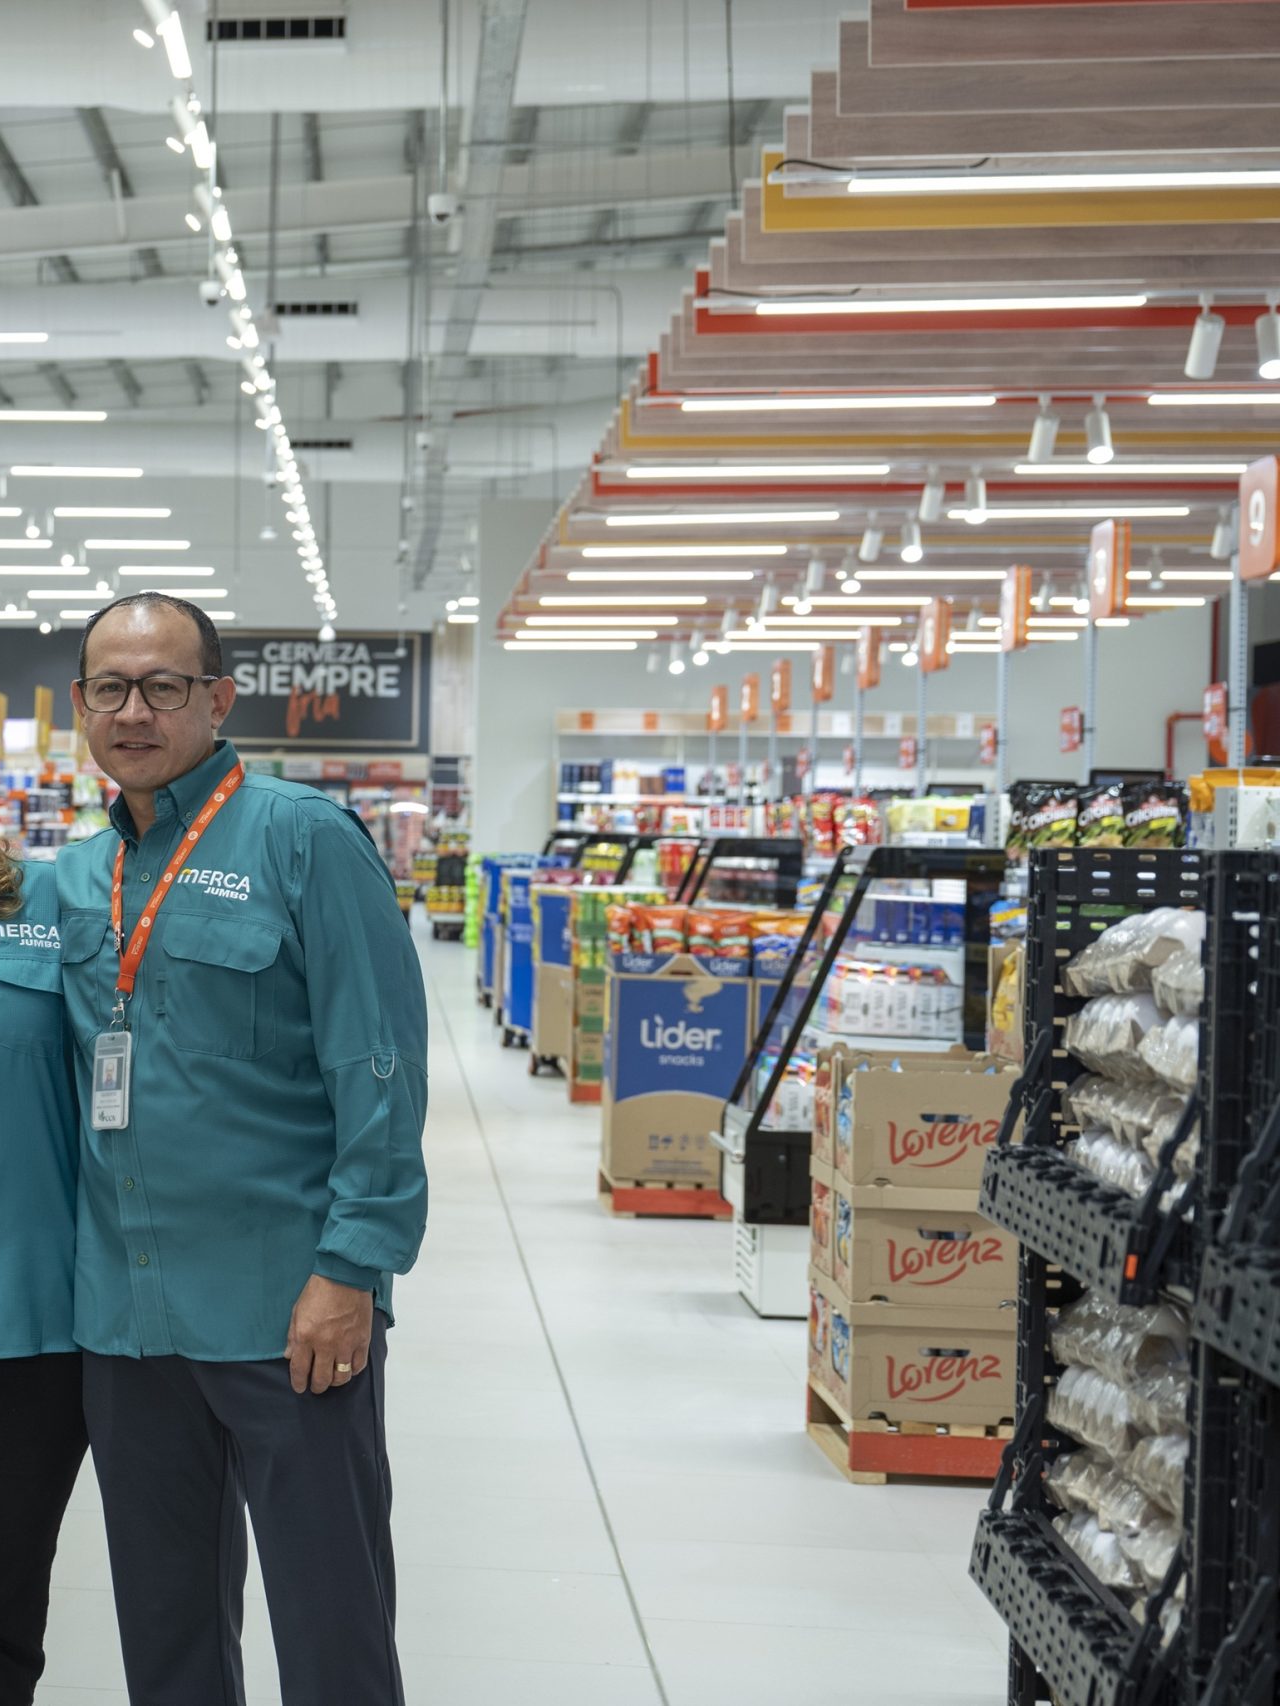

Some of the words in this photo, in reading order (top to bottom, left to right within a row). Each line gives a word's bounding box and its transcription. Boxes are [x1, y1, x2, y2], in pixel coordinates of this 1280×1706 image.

[262, 641, 371, 664] CERVEZA
[233, 663, 401, 698] SIEMPRE
[204, 886, 248, 901] JUMBO
[19, 939, 61, 949] JUMBO
[659, 1053, 705, 1067] snacks
[887, 1119, 1001, 1168] Lorenz
[887, 1237, 1004, 1287] Lorenz
[886, 1354, 1002, 1402] Lorenz
